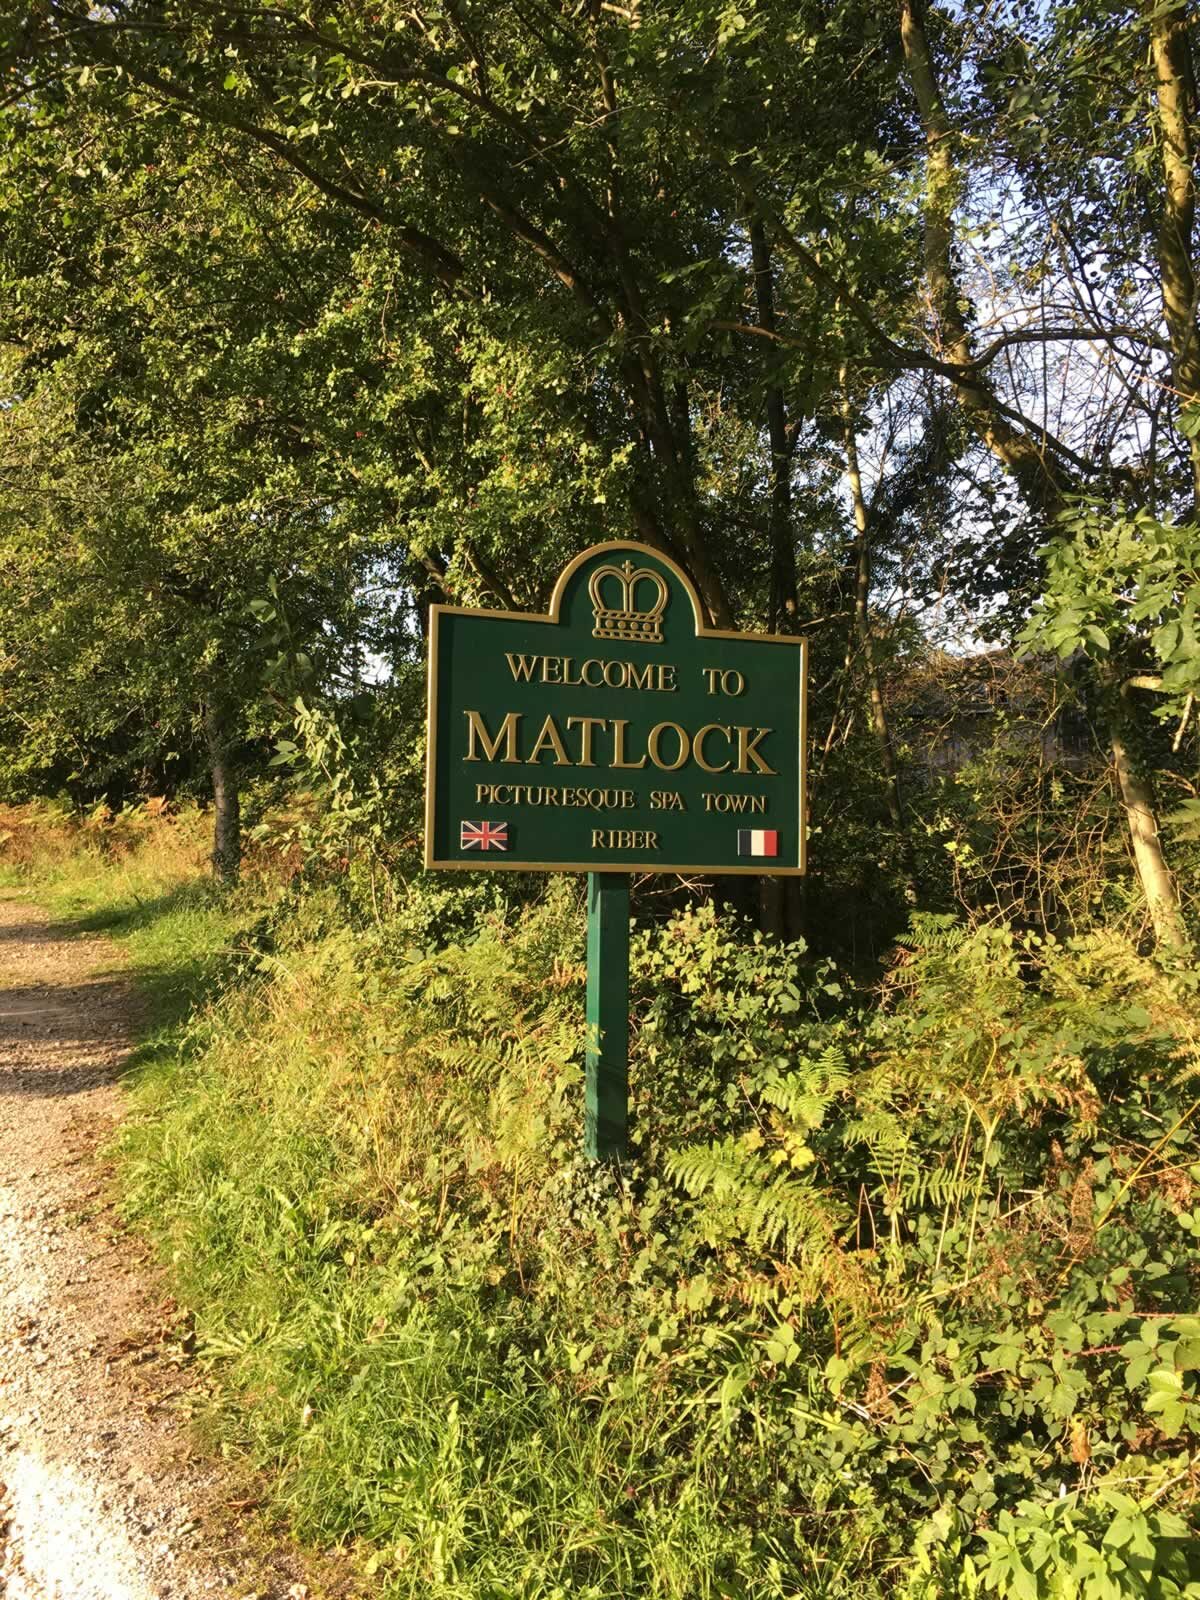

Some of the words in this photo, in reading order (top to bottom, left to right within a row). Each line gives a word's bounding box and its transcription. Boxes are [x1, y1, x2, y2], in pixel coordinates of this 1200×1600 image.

[504, 652, 677, 692] WELCOME
[702, 668, 745, 697] TO
[463, 710, 776, 775] MATLOCK
[475, 783, 636, 812] PICTURESQUE
[649, 790, 686, 810] SPA
[702, 793, 766, 814] TOWN
[591, 829, 659, 849] RIBER
